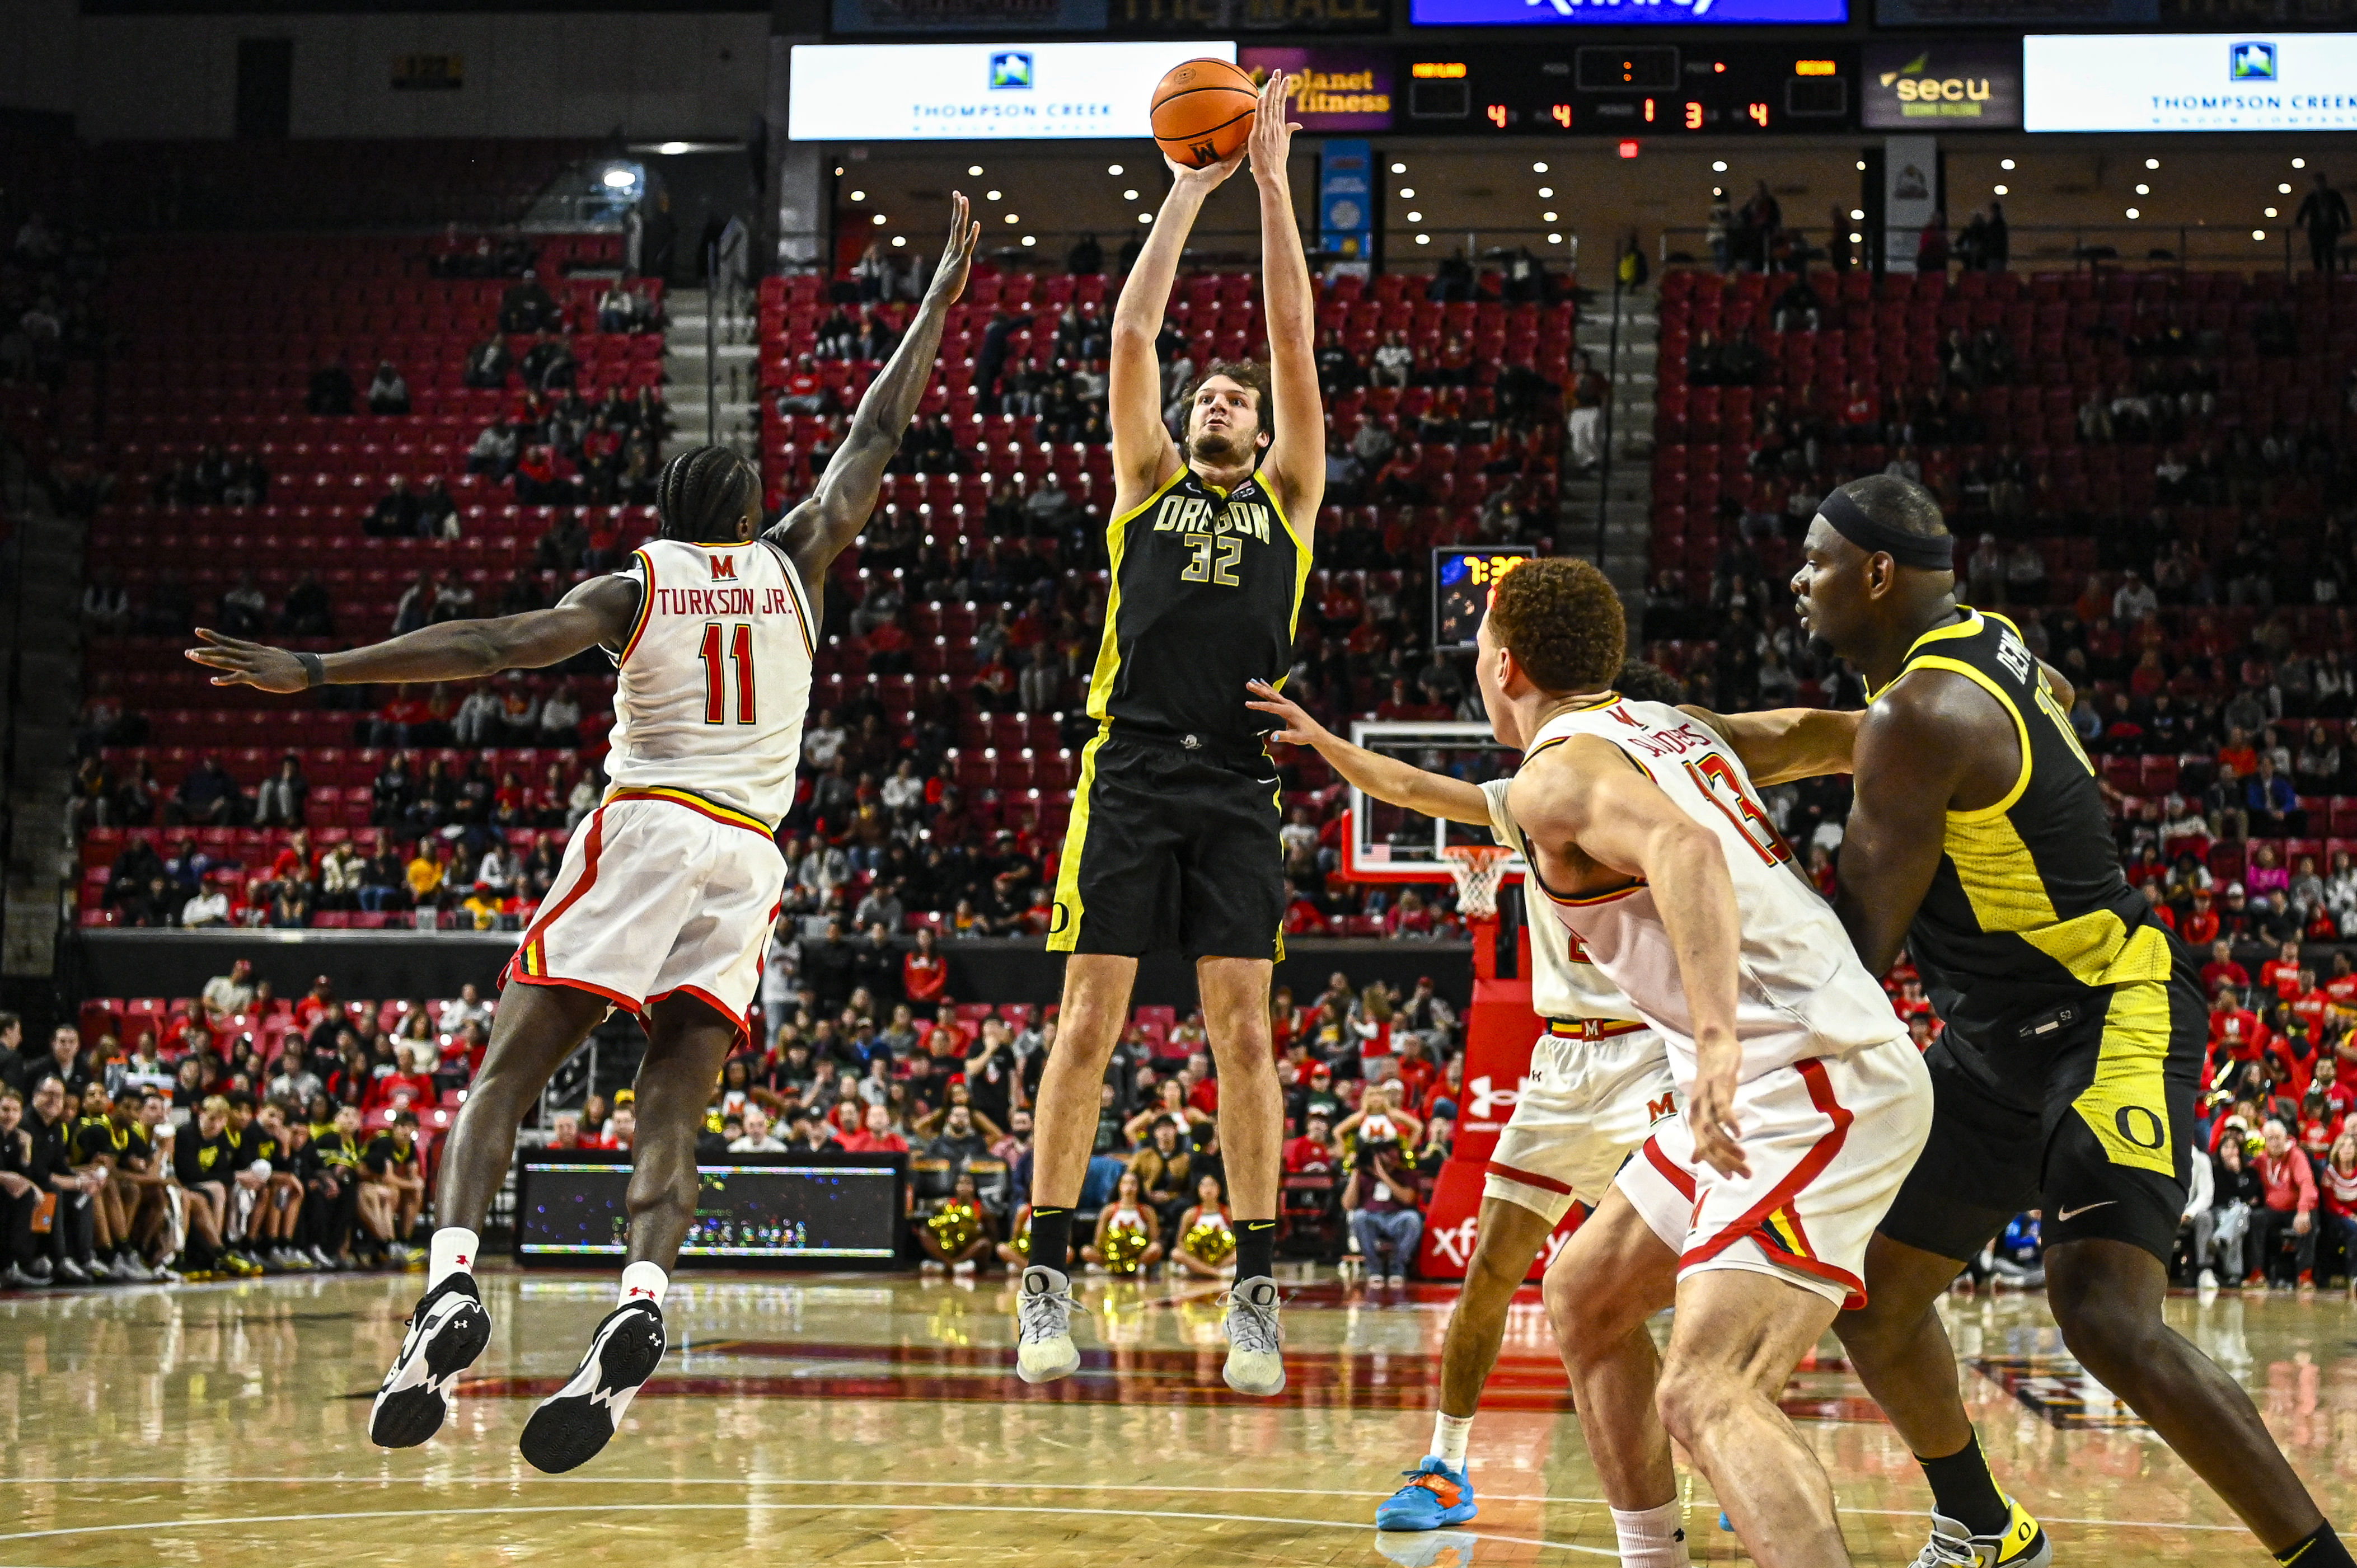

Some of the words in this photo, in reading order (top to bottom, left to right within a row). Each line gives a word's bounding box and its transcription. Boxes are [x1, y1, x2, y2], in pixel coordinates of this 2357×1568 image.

[1286, 68, 1374, 96] planet
[1897, 78, 1990, 101] secu
[912, 103, 1036, 116] THOMPSON
[1045, 103, 1110, 116] CREEK
[1296, 90, 1390, 112] fitness
[1645, 98, 1654, 122] 1
[2151, 95, 2280, 110] THOMPSON
[1487, 104, 1506, 128] 4
[1552, 104, 1571, 128] 4
[1685, 101, 1703, 129] 3
[1749, 103, 1768, 126] 4
[1153, 495, 1270, 545] OREGON
[709, 554, 739, 580] M
[1181, 532, 1243, 587] 32
[657, 588, 754, 615] TURKSON
[762, 588, 793, 614] JR.
[697, 622, 757, 725] 11
[1681, 751, 1792, 867] 13
